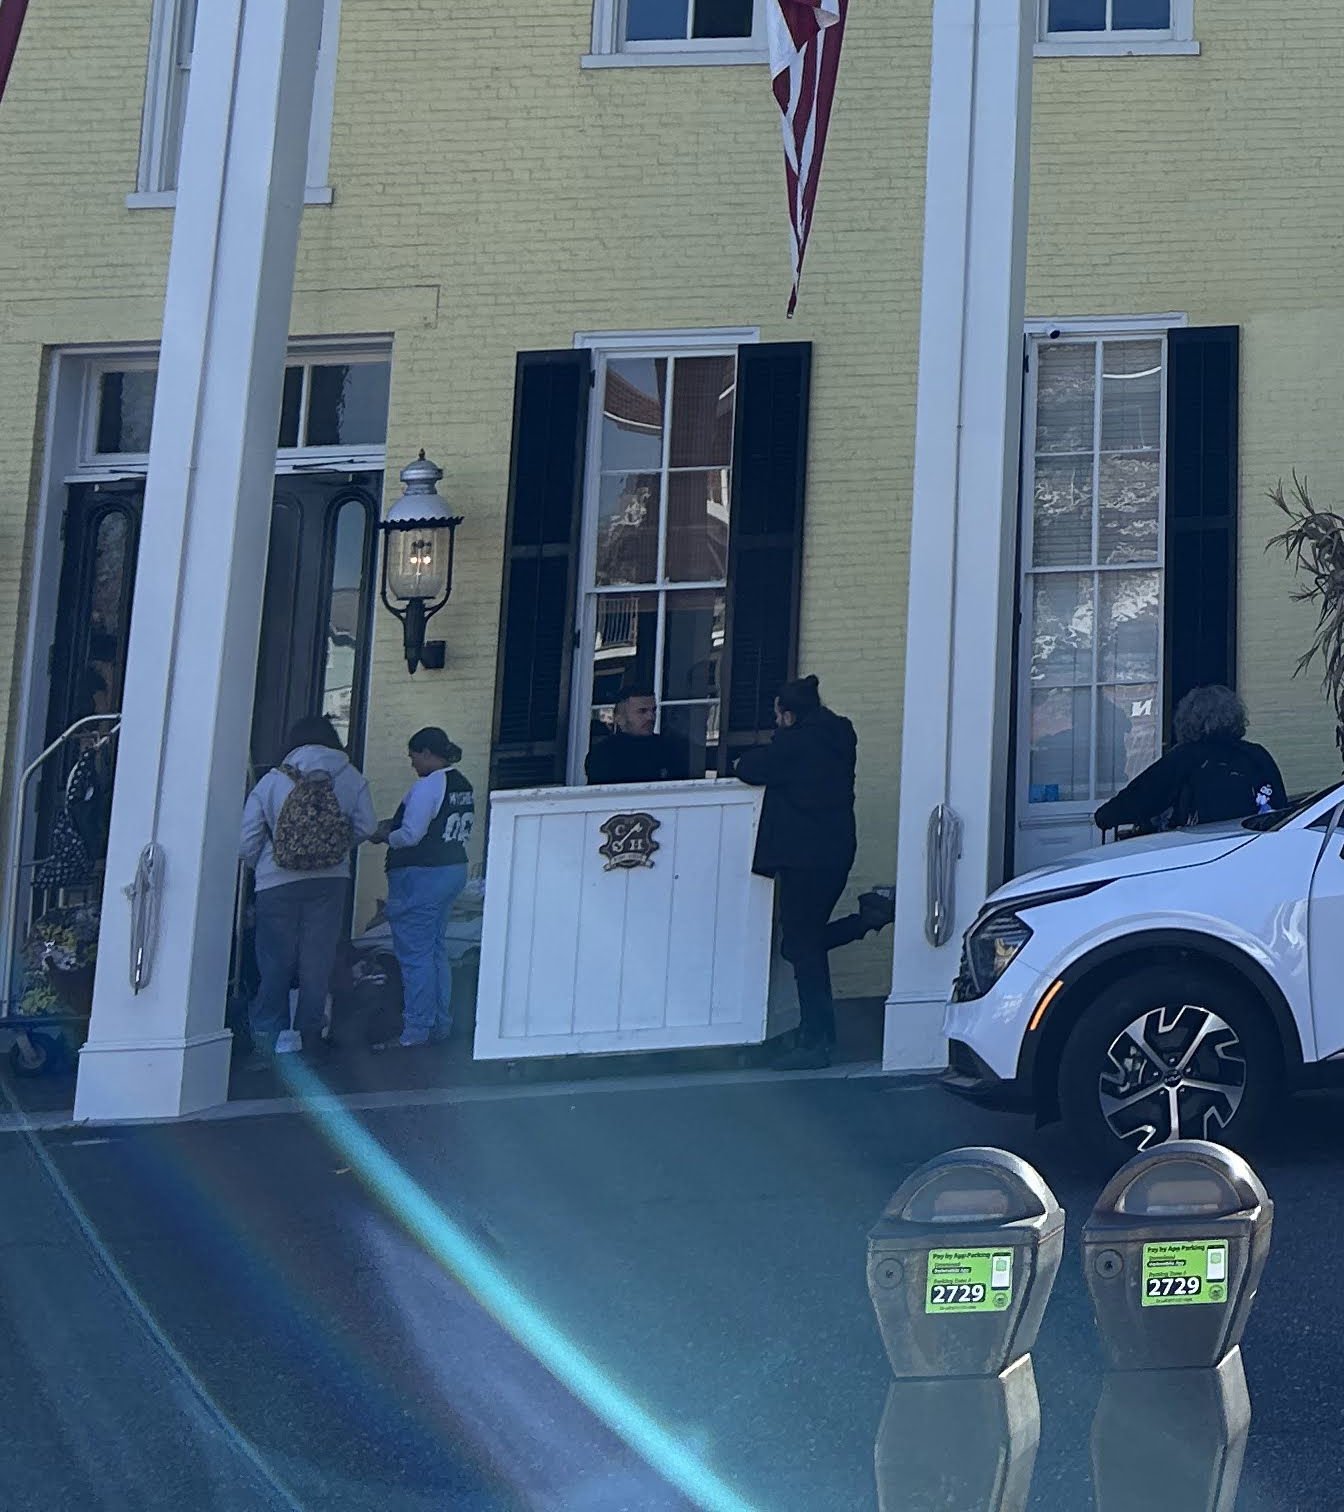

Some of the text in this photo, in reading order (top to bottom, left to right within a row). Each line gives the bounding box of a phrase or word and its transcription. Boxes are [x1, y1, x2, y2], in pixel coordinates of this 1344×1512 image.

[630, 838, 643, 850] H
[932, 1284, 984, 1303] 2729
[1148, 1277, 1200, 1296] 2729
